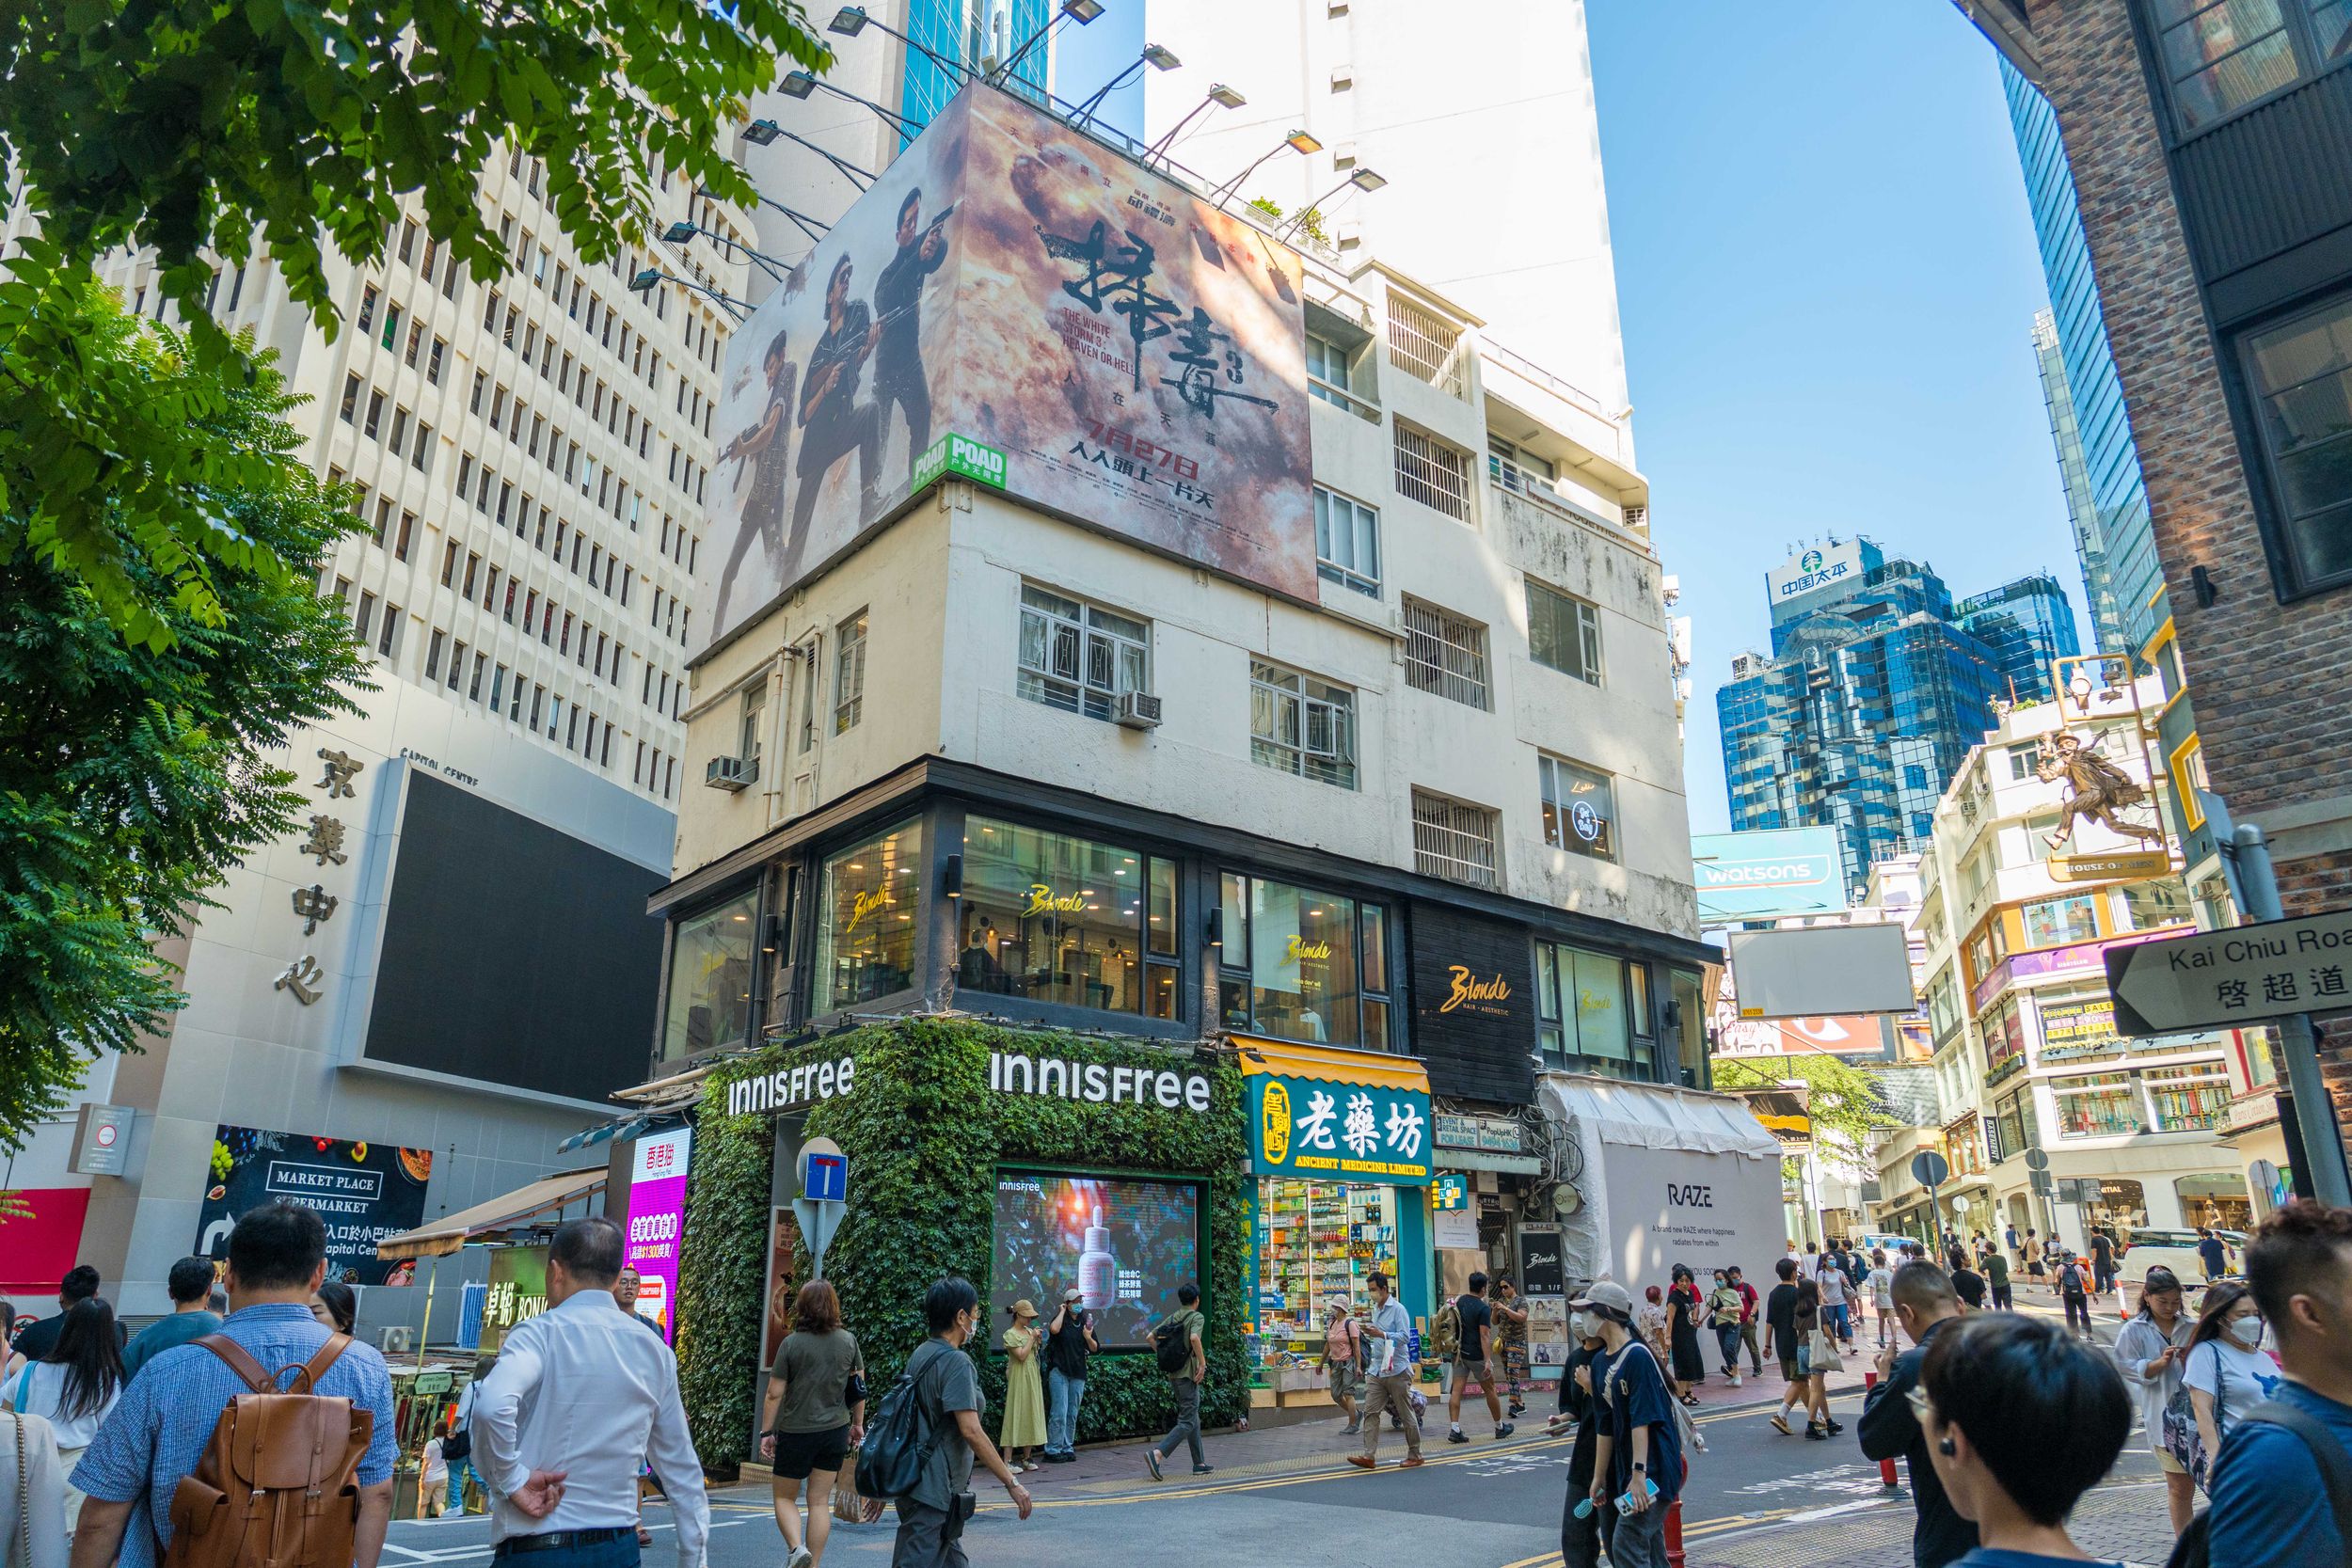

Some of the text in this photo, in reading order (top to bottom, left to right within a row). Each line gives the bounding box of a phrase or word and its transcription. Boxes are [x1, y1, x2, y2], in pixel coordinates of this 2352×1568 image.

[1063, 308, 1111, 338] THE WHITE
[1063, 322, 1095, 344] STORM
[1062, 335, 1136, 376] HEAVEN OR HELL
[915, 439, 946, 480] POAD
[952, 437, 1003, 473] POAD
[1085, 417, 1200, 481] 7月27日
[1069, 440, 1215, 510] 人人頭上一片天
[1782, 562, 1848, 595] 中国太平
[399, 747, 479, 787] CAPITOL CENTRE
[275, 747, 364, 1005] 京華中心
[1706, 863, 1811, 883] watsons
[2065, 863, 2105, 873] HOUSE
[1021, 883, 1088, 919] Blonde
[1279, 934, 1332, 966] Blonde
[2169, 928, 2352, 972] Kai Chiu Roa
[1439, 965, 1512, 1013] Blonde
[1462, 1003, 1509, 1017] HAIR AESTHETIC
[2086, 1002, 2112, 1013] SALE
[1295, 1090, 1424, 1159] 老藥坊
[1442, 1124, 1476, 1134] RETAIL SPACE
[1441, 1134, 1475, 1146] FOR LEASE
[1986, 1118, 2000, 1160] BASEMENT
[1295, 1155, 1426, 1177] ANCIENT MEDICINE LIMITED
[276, 1170, 374, 1191] MARKET PLACE
[2101, 1185, 2122, 1194] NITIAL
[1667, 1183, 1712, 1208] RAZE
[1697, 1227, 1712, 1235] where
[1712, 1227, 1736, 1237] happiness
[326, 1243, 377, 1257] apitol Cen
[1526, 1253, 1558, 1269] Blonde
[1703, 1267, 1717, 1275] SOO
[517, 1295, 548, 1322] BONJ
[1620, 1379, 1629, 1396] B
